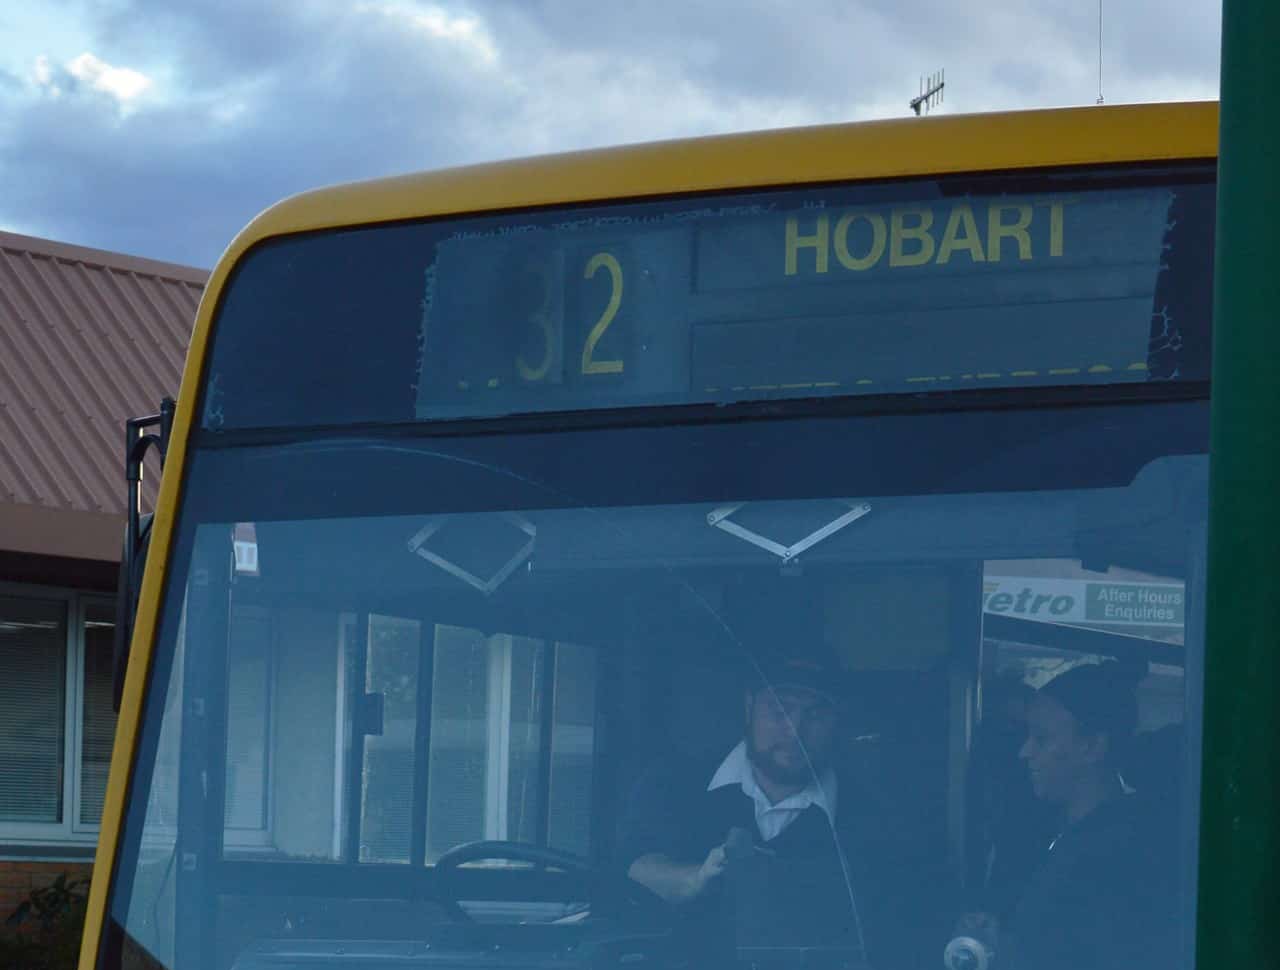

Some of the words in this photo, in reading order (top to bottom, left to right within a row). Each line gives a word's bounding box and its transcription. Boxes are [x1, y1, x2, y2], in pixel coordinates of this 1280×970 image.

[784, 198, 1070, 276] HOBART
[983, 586, 1075, 616] etro
[1098, 588, 1135, 604] After
[1138, 589, 1183, 605] Hours
[1104, 603, 1175, 621] Enquiries
